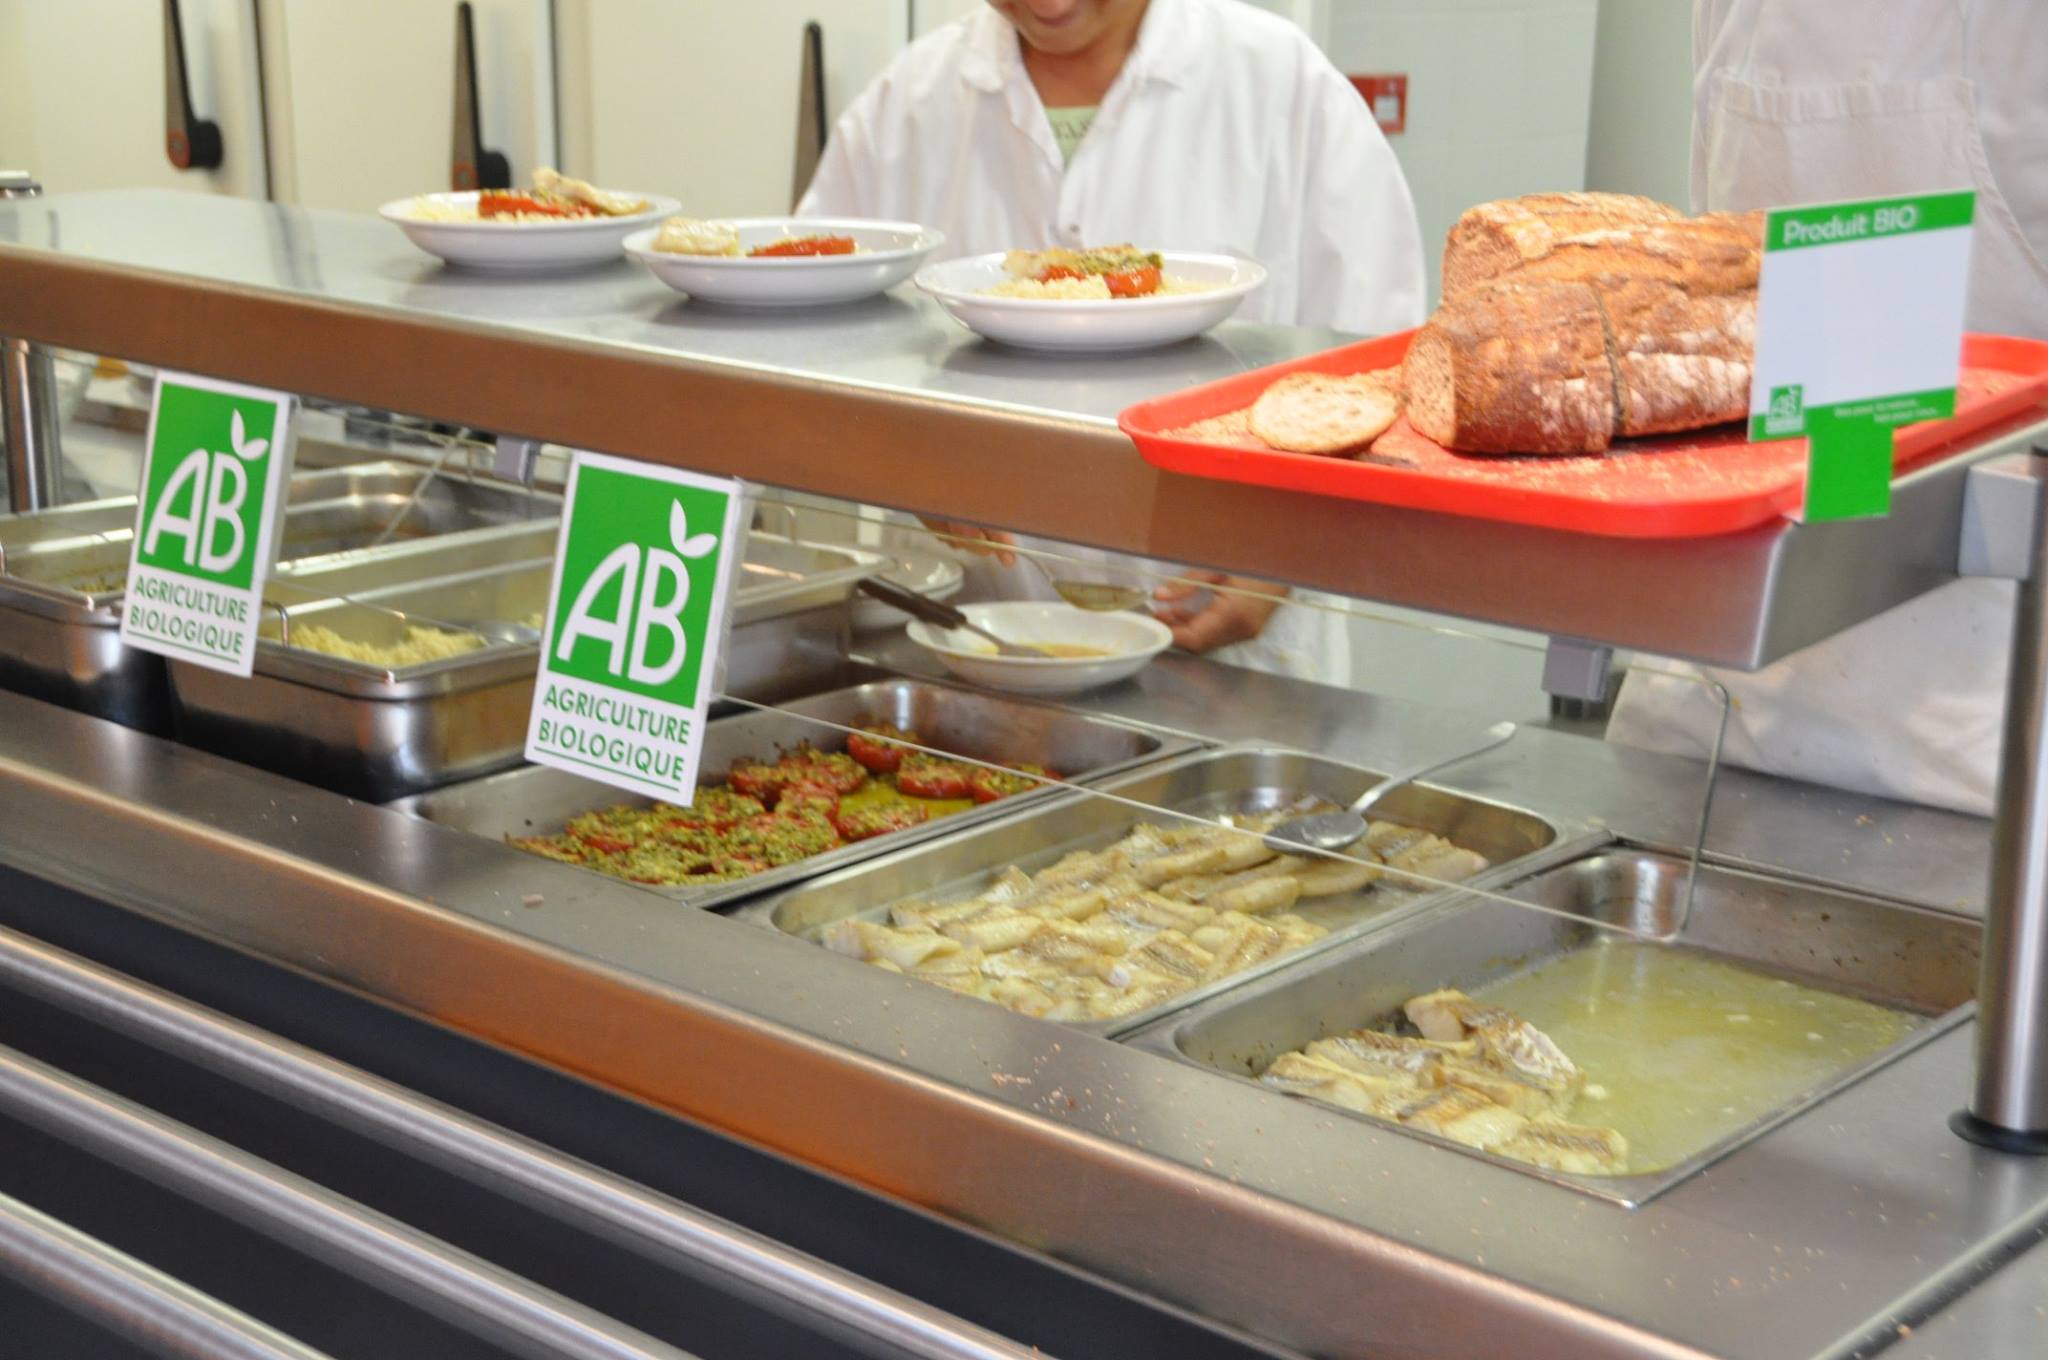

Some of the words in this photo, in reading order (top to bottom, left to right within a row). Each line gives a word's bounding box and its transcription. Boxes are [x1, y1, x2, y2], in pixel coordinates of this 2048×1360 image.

[1783, 213, 1868, 245] Produit
[1873, 205, 1917, 233] BIO
[144, 448, 248, 573] AB
[134, 574, 249, 624] AGRICULTURE
[556, 541, 690, 686] AB
[129, 605, 244, 656] BIOLOGIQUE
[544, 684, 691, 745] AGRICULTURE
[538, 718, 685, 782] BIOLOGIQUE
